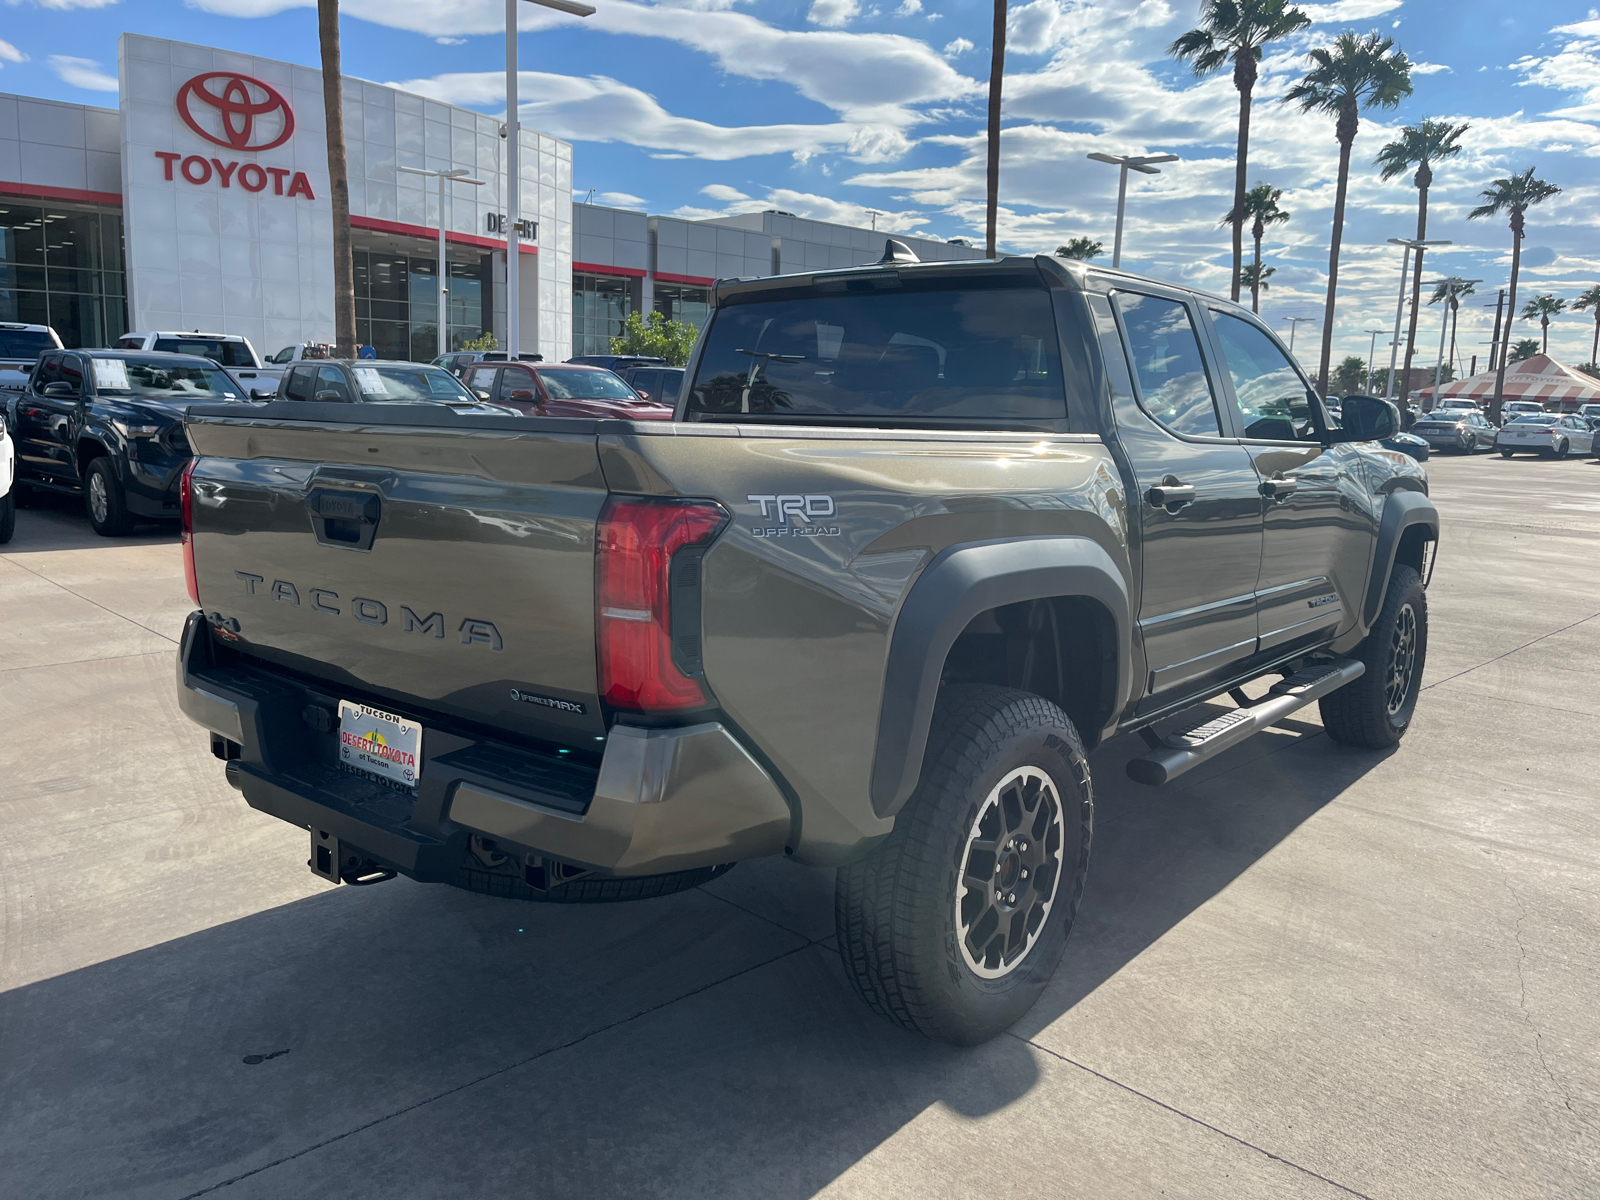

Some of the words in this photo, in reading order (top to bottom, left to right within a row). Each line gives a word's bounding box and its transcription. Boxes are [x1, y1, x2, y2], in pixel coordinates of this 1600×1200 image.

[155, 151, 316, 200] TOYOTA
[321, 500, 353, 513] TOYOTA
[747, 494, 834, 523] TRD
[752, 527, 788, 538] OFF
[791, 527, 840, 537] ROAD
[234, 570, 504, 651] TACOMA
[1311, 594, 1341, 608] TACOMA
[360, 705, 400, 724] TUCSON
[342, 731, 374, 753] DESERT
[377, 743, 415, 768] TOYOTA
[358, 753, 366, 761] of
[366, 755, 389, 769] Tucson
[340, 762, 373, 781] DESERT
[374, 774, 414, 797] TOYOTA
